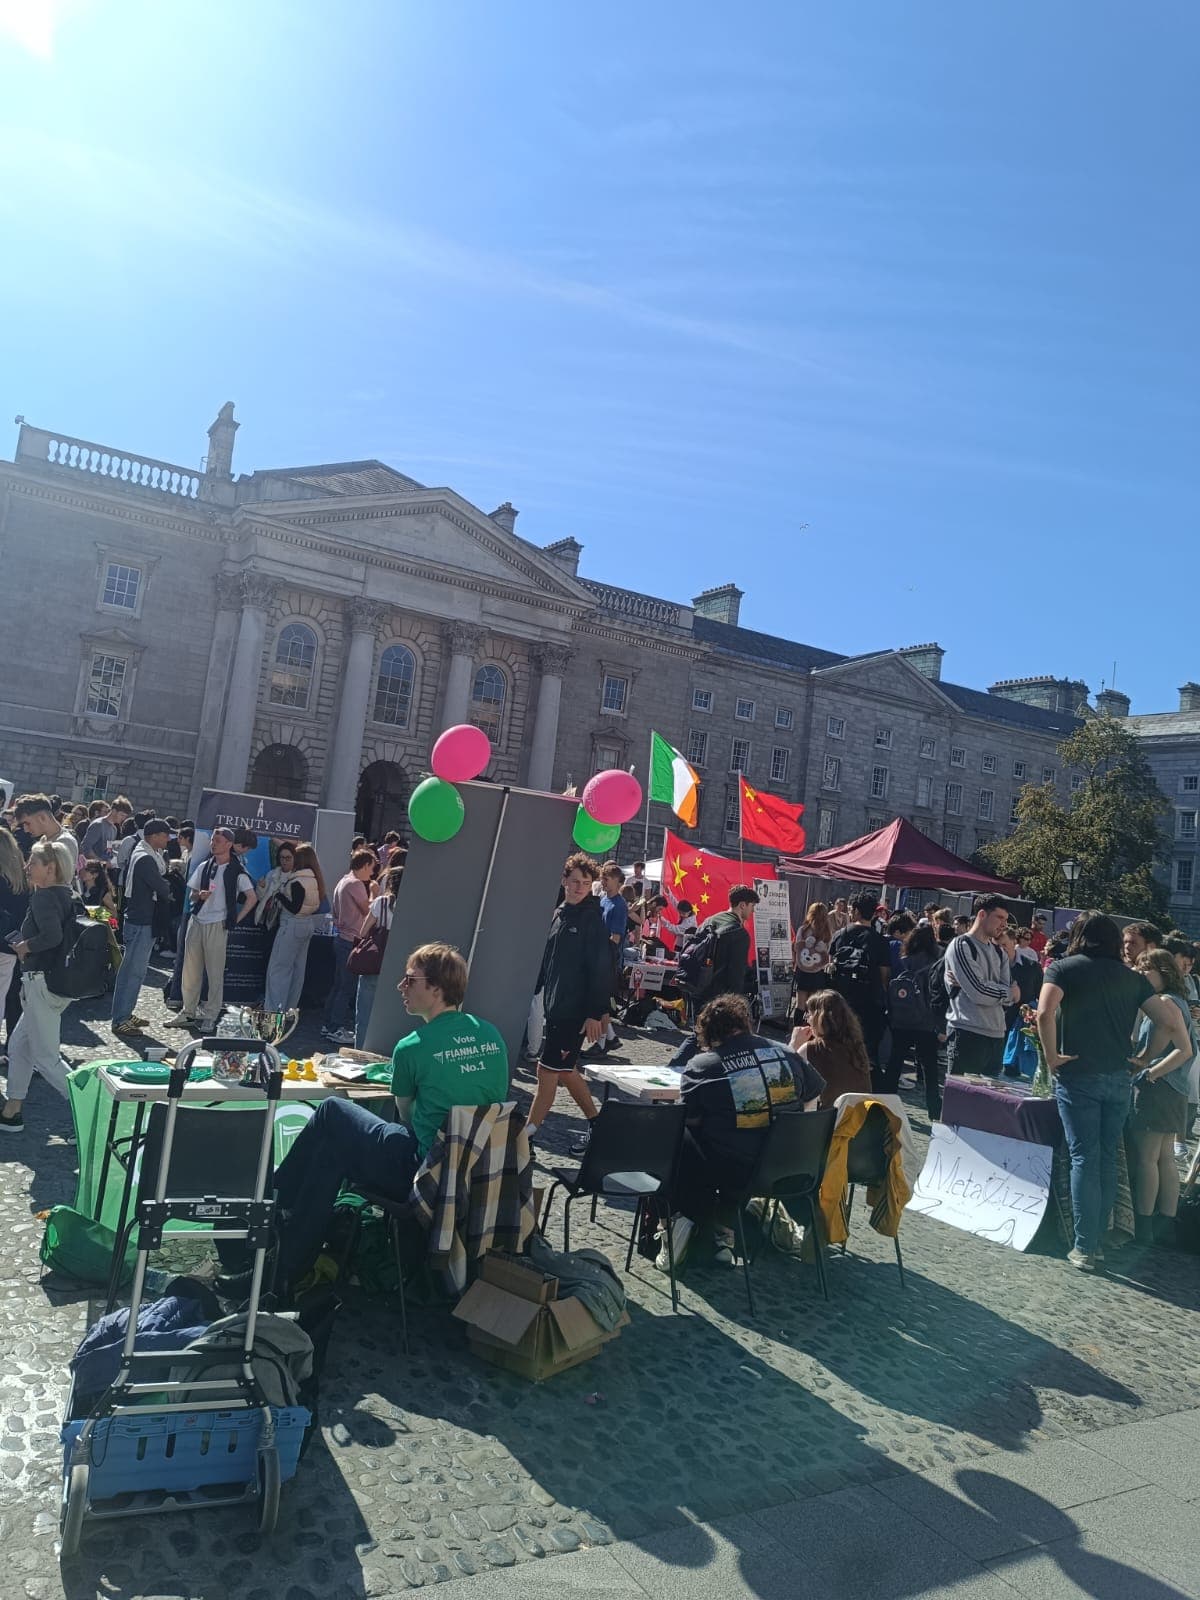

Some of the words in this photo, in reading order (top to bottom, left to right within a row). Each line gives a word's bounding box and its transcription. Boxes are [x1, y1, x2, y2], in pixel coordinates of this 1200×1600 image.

[216, 814, 273, 830] TRINITY
[275, 821, 301, 834] SMF
[453, 1035, 476, 1045] Vote
[445, 1045, 479, 1059] FIANNA
[460, 1061, 486, 1074] No.1
